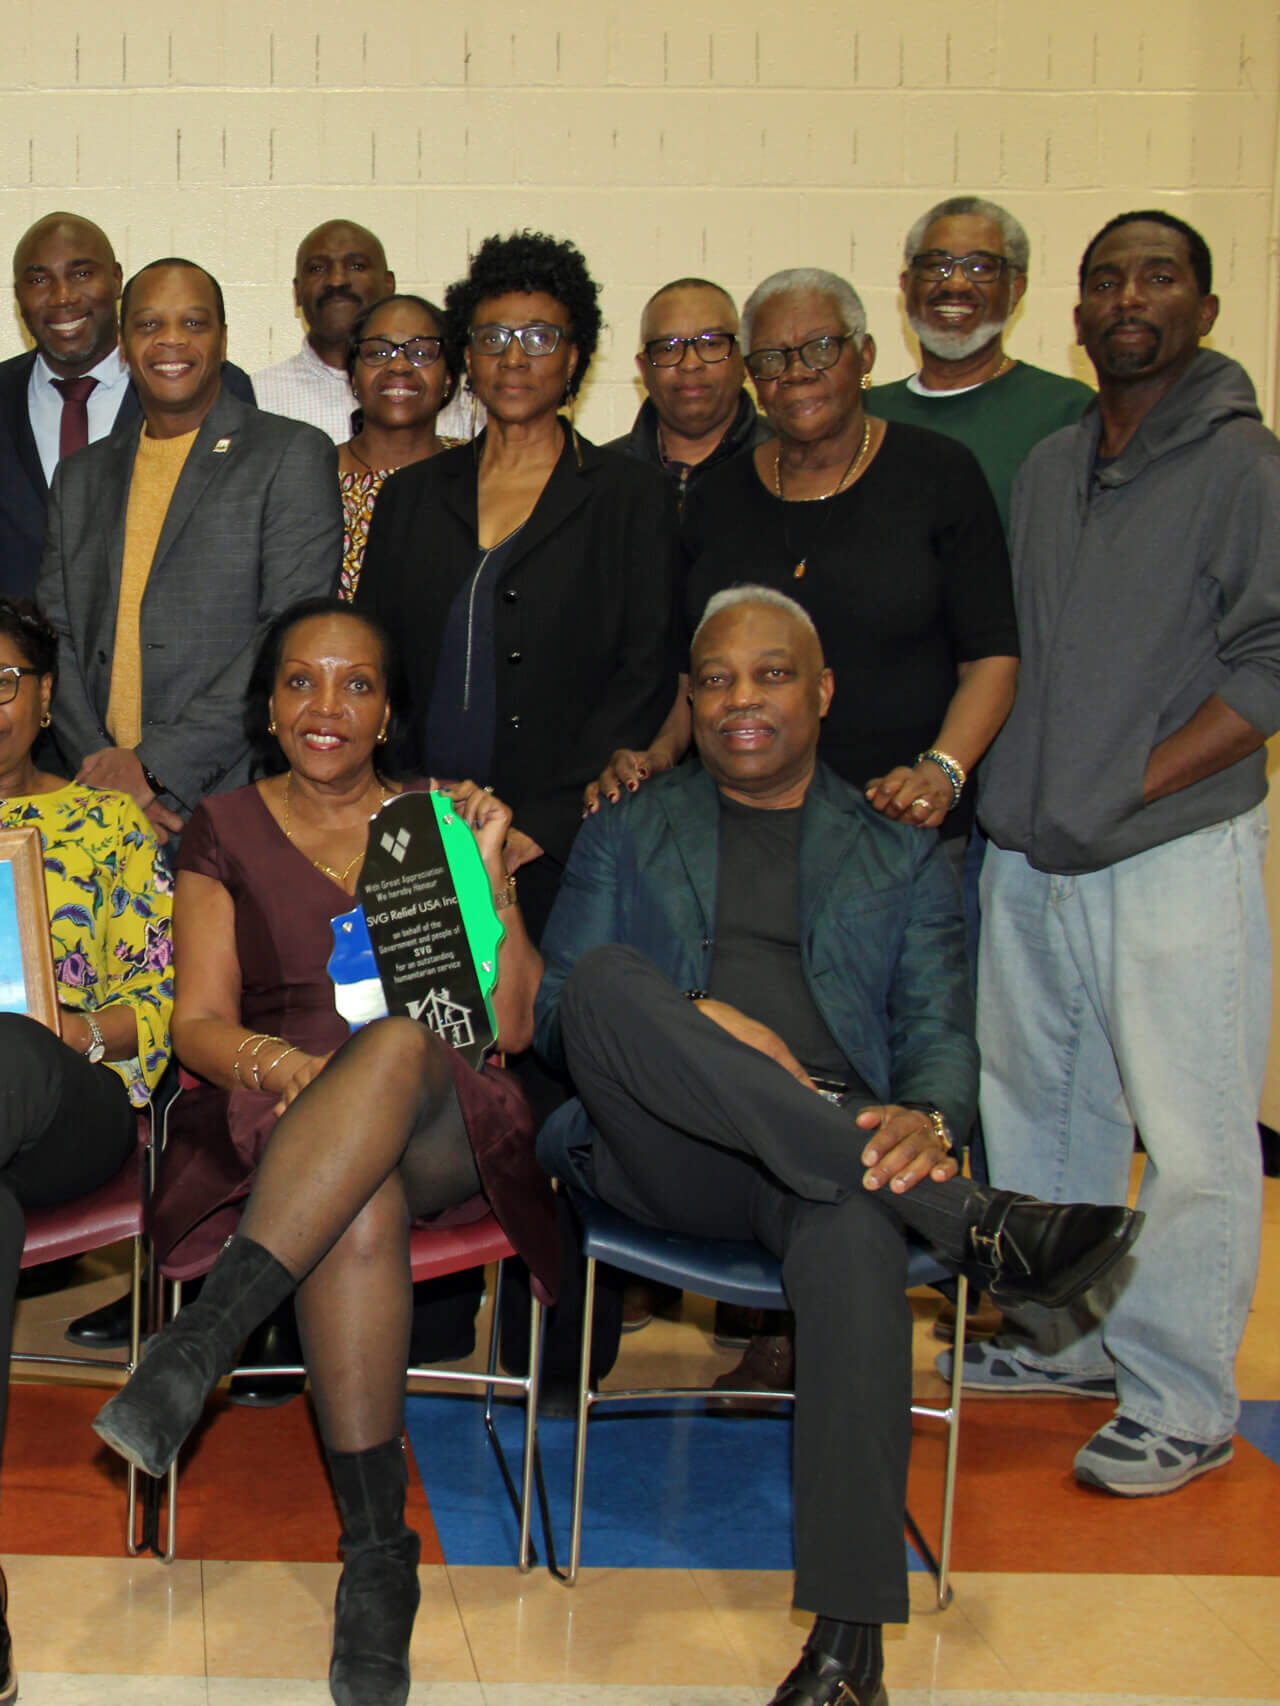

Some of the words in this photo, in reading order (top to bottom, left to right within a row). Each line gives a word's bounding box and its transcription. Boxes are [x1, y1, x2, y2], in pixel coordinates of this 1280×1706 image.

[365, 883, 380, 894] With
[380, 878, 401, 890] Great
[401, 866, 444, 885] Appreciation
[376, 892, 388, 902] We
[388, 886, 413, 899] hereby
[366, 912, 389, 927] SVG
[389, 903, 418, 921] Relief
[417, 898, 441, 914] USA
[378, 938, 418, 955] Government
[418, 933, 431, 944] and
[431, 928, 453, 942] people
[453, 924, 460, 935] of
[392, 931, 401, 940] on
[401, 923, 422, 938] behalf
[422, 921, 430, 932] of
[430, 920, 442, 930] the
[395, 963, 407, 973] for
[407, 961, 416, 970] an
[415, 951, 455, 968] outstanding
[413, 944, 432, 958] SVG
[393, 967, 437, 985] humanitarian
[436, 960, 461, 974] service
